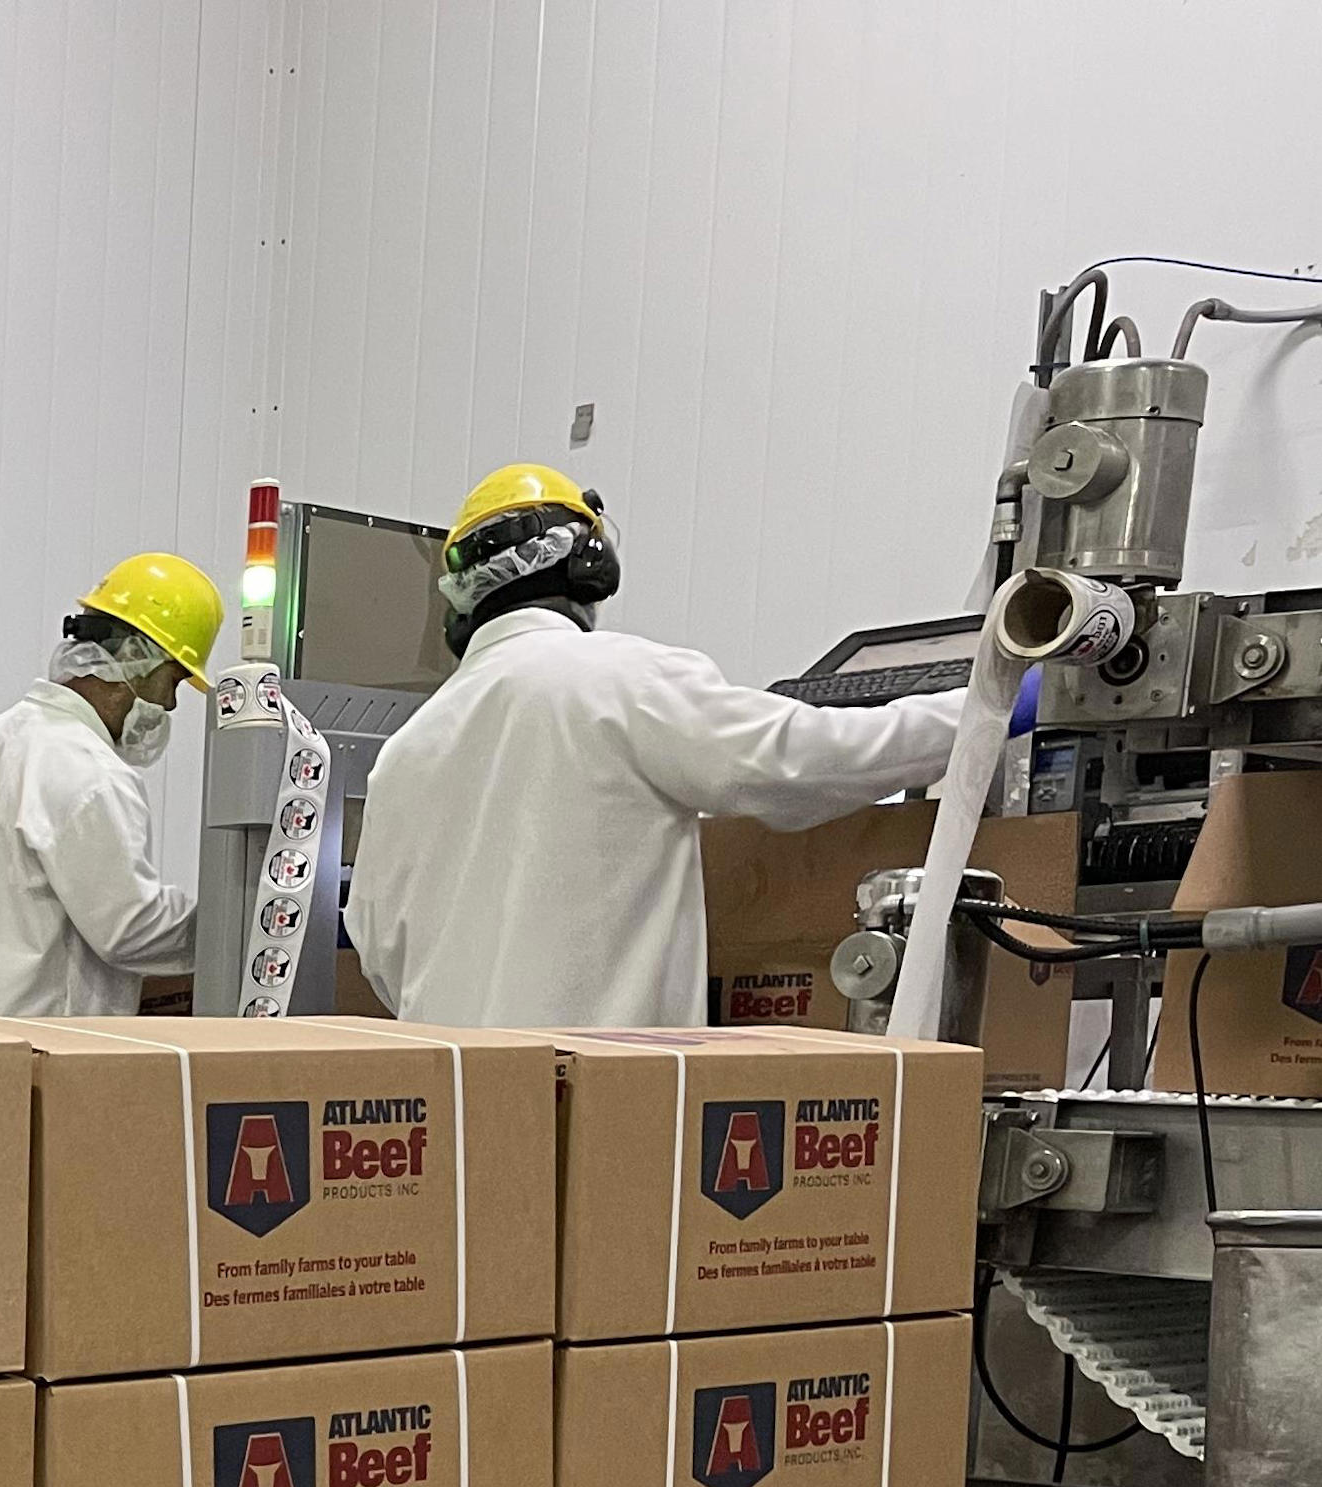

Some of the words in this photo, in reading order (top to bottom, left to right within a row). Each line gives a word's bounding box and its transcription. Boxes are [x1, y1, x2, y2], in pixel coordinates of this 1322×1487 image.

[731, 973, 814, 990] ATLANTIC
[730, 989, 813, 1018] Beef
[322, 1098, 427, 1127] ATLANTIC
[795, 1098, 879, 1123] ATLANTIC
[322, 1124, 427, 1181] Beef
[794, 1121, 879, 1170] Beef
[323, 1184, 392, 1202] PRODUCTS
[217, 1261, 251, 1279] From
[254, 1258, 295, 1277] family
[297, 1257, 335, 1273] farms
[337, 1255, 351, 1270] to
[353, 1255, 382, 1272] your
[384, 1249, 416, 1266] table
[204, 1290, 230, 1307] Des
[232, 1288, 280, 1305] fermes
[282, 1282, 346, 1301] familiales
[358, 1280, 391, 1295] votre
[394, 1276, 426, 1293] table
[786, 1372, 870, 1403] ATLANTIC
[328, 1404, 431, 1440] ATLANTIC
[785, 1395, 870, 1449] Beef
